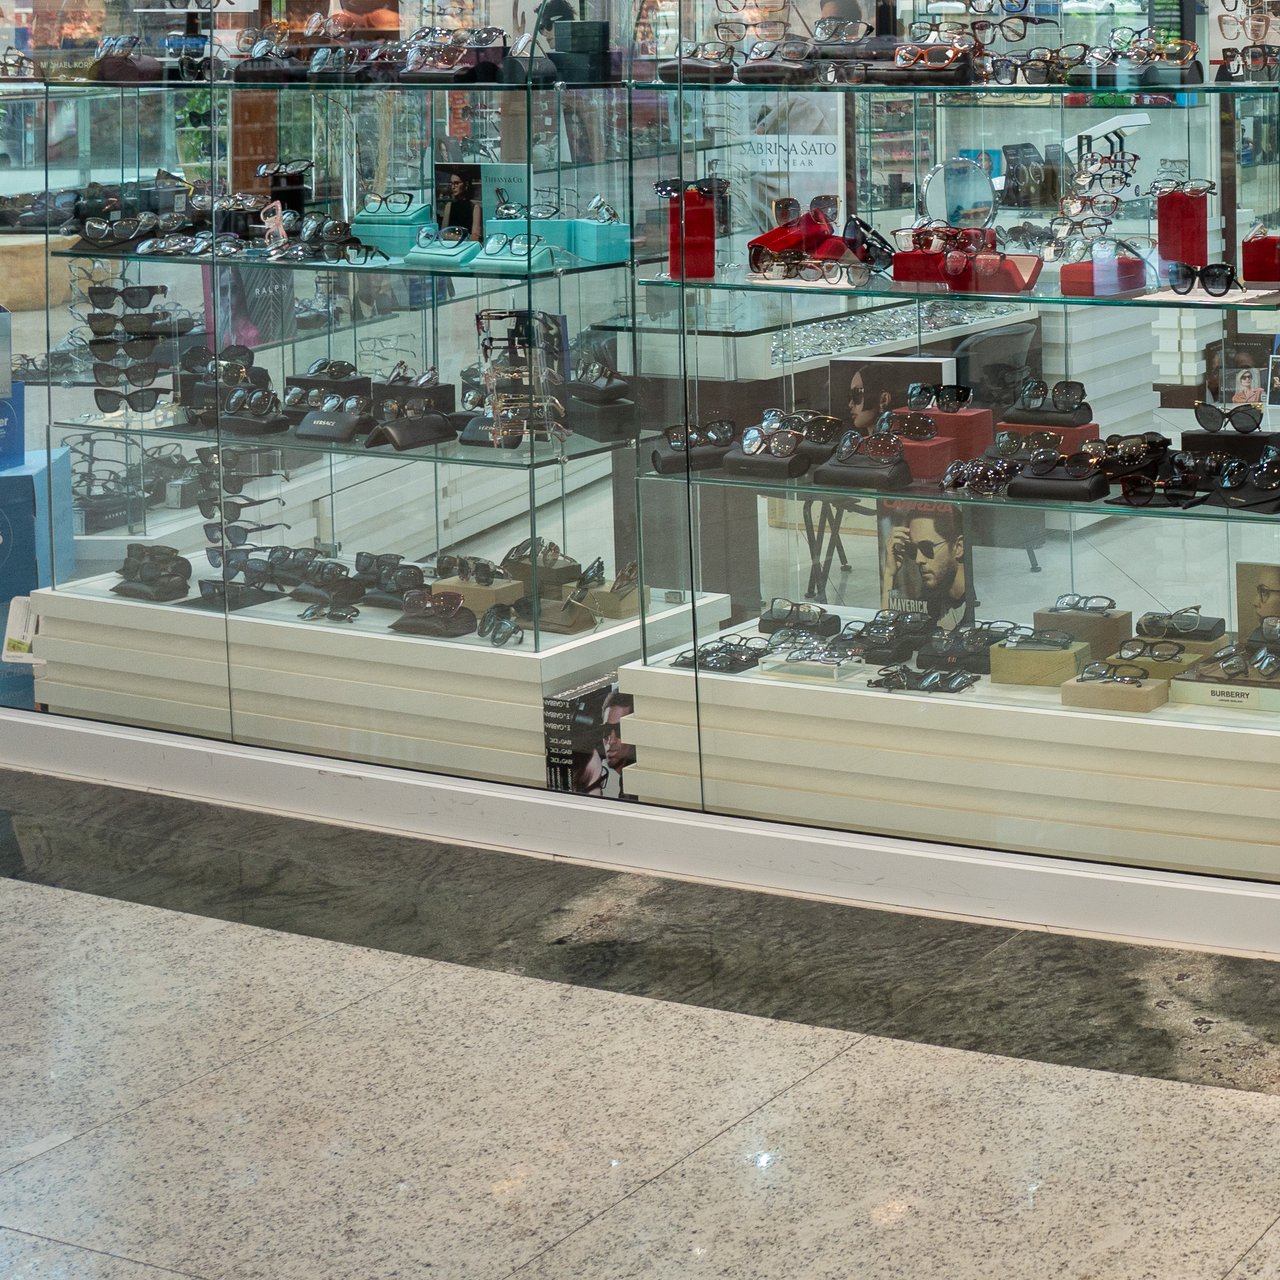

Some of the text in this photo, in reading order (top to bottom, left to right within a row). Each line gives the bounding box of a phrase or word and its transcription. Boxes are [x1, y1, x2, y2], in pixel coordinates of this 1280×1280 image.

[800, 140, 837, 156] SATO
[255, 283, 288, 296] RALPH
[888, 598, 929, 614] MAVERICK
[1210, 690, 1250, 699] BURBERRY
